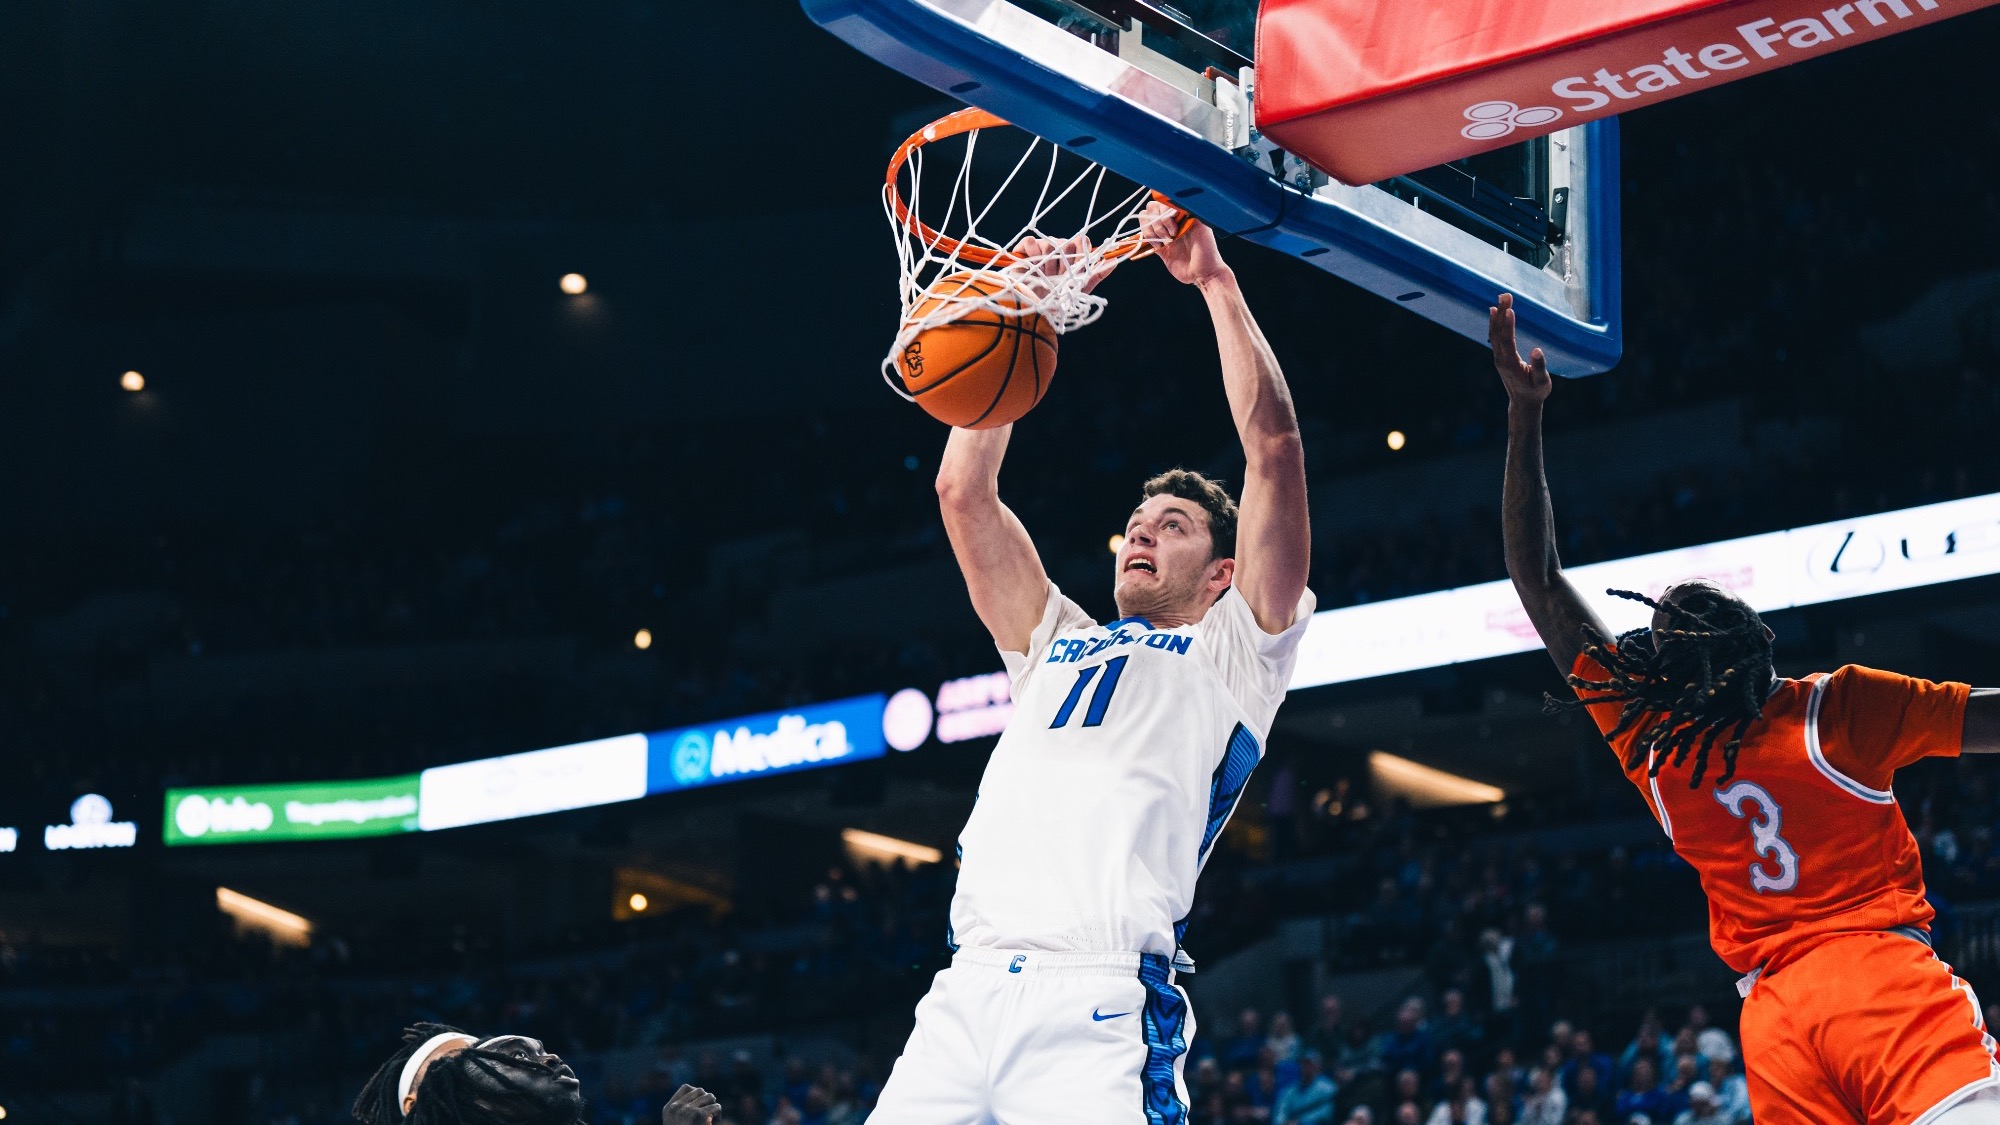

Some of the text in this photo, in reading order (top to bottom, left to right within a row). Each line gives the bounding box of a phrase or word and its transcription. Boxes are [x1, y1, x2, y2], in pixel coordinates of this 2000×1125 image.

[1048, 654, 1130, 730] 11
[710, 714, 850, 778] Medica
[1713, 780, 1800, 895] 3
[1008, 954, 1027, 974] C
